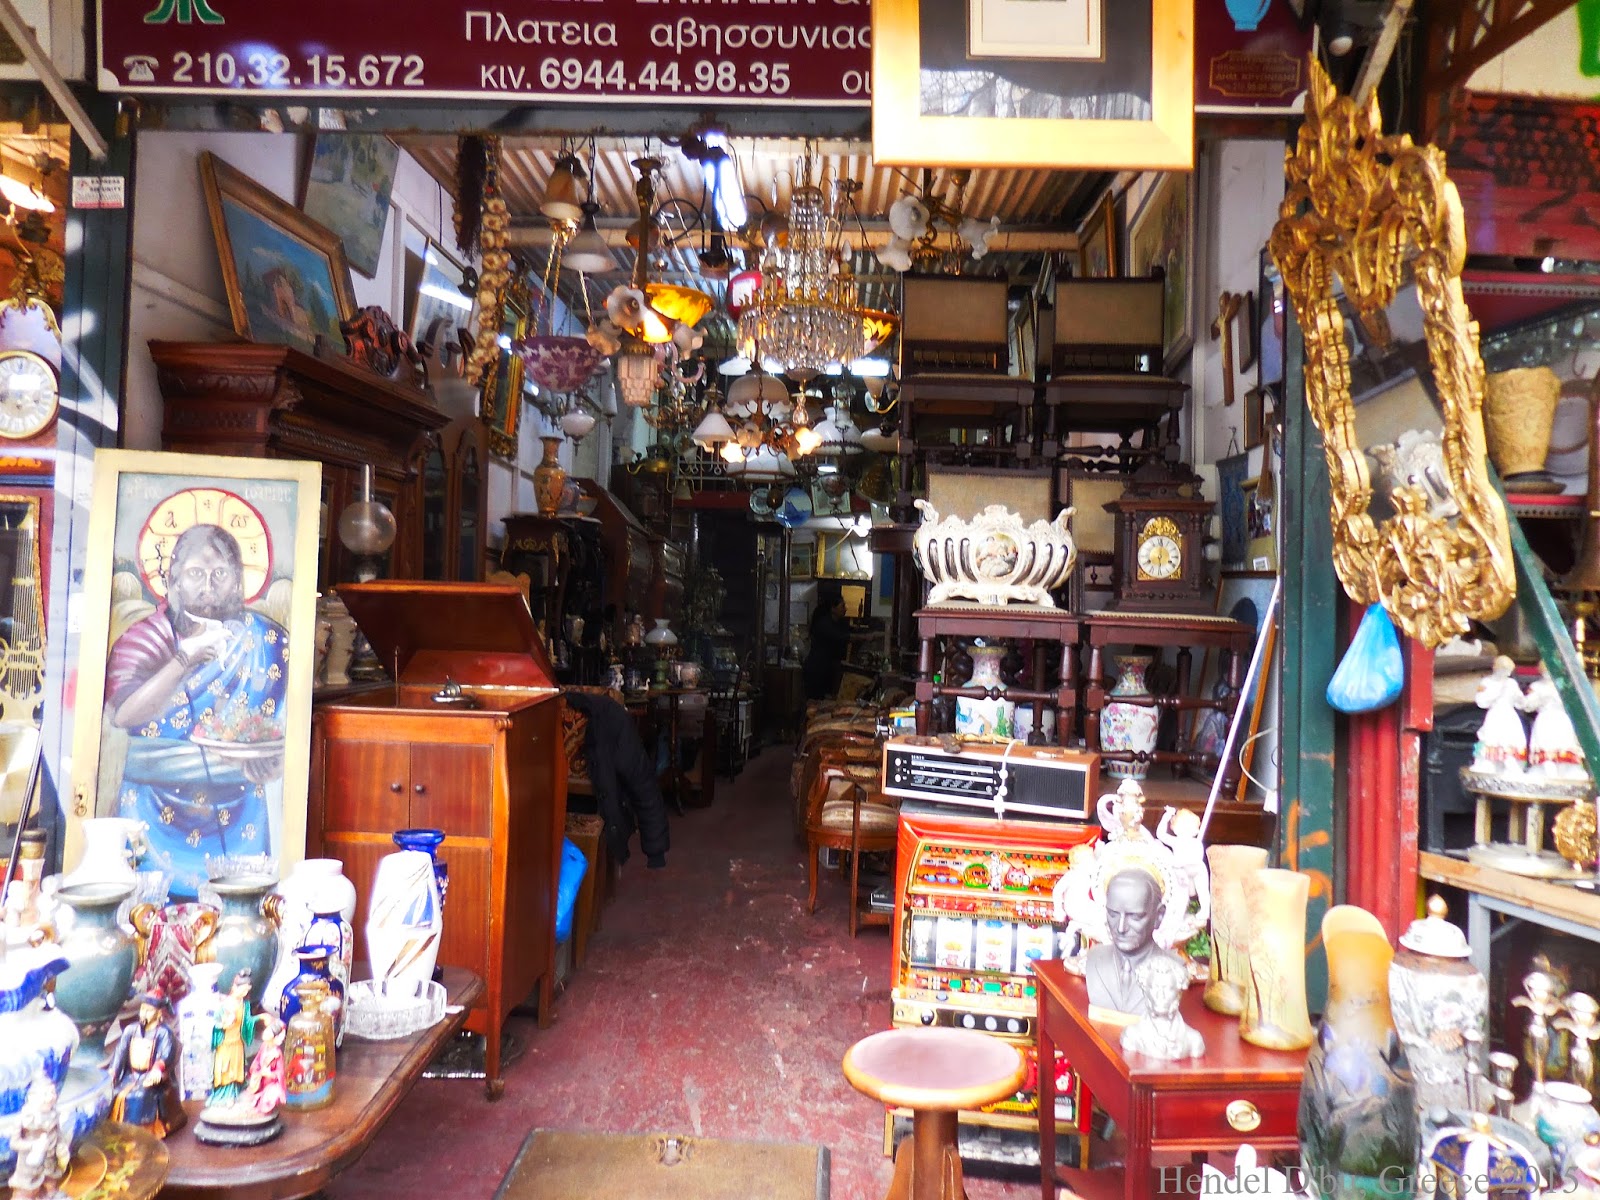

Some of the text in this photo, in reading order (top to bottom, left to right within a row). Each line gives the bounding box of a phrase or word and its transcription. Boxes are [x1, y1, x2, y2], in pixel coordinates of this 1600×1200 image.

[465, 11, 618, 47] Πλατεια
[172, 51, 425, 87] 210.32.15.672
[539, 57, 791, 94] 6944.44.98.35
